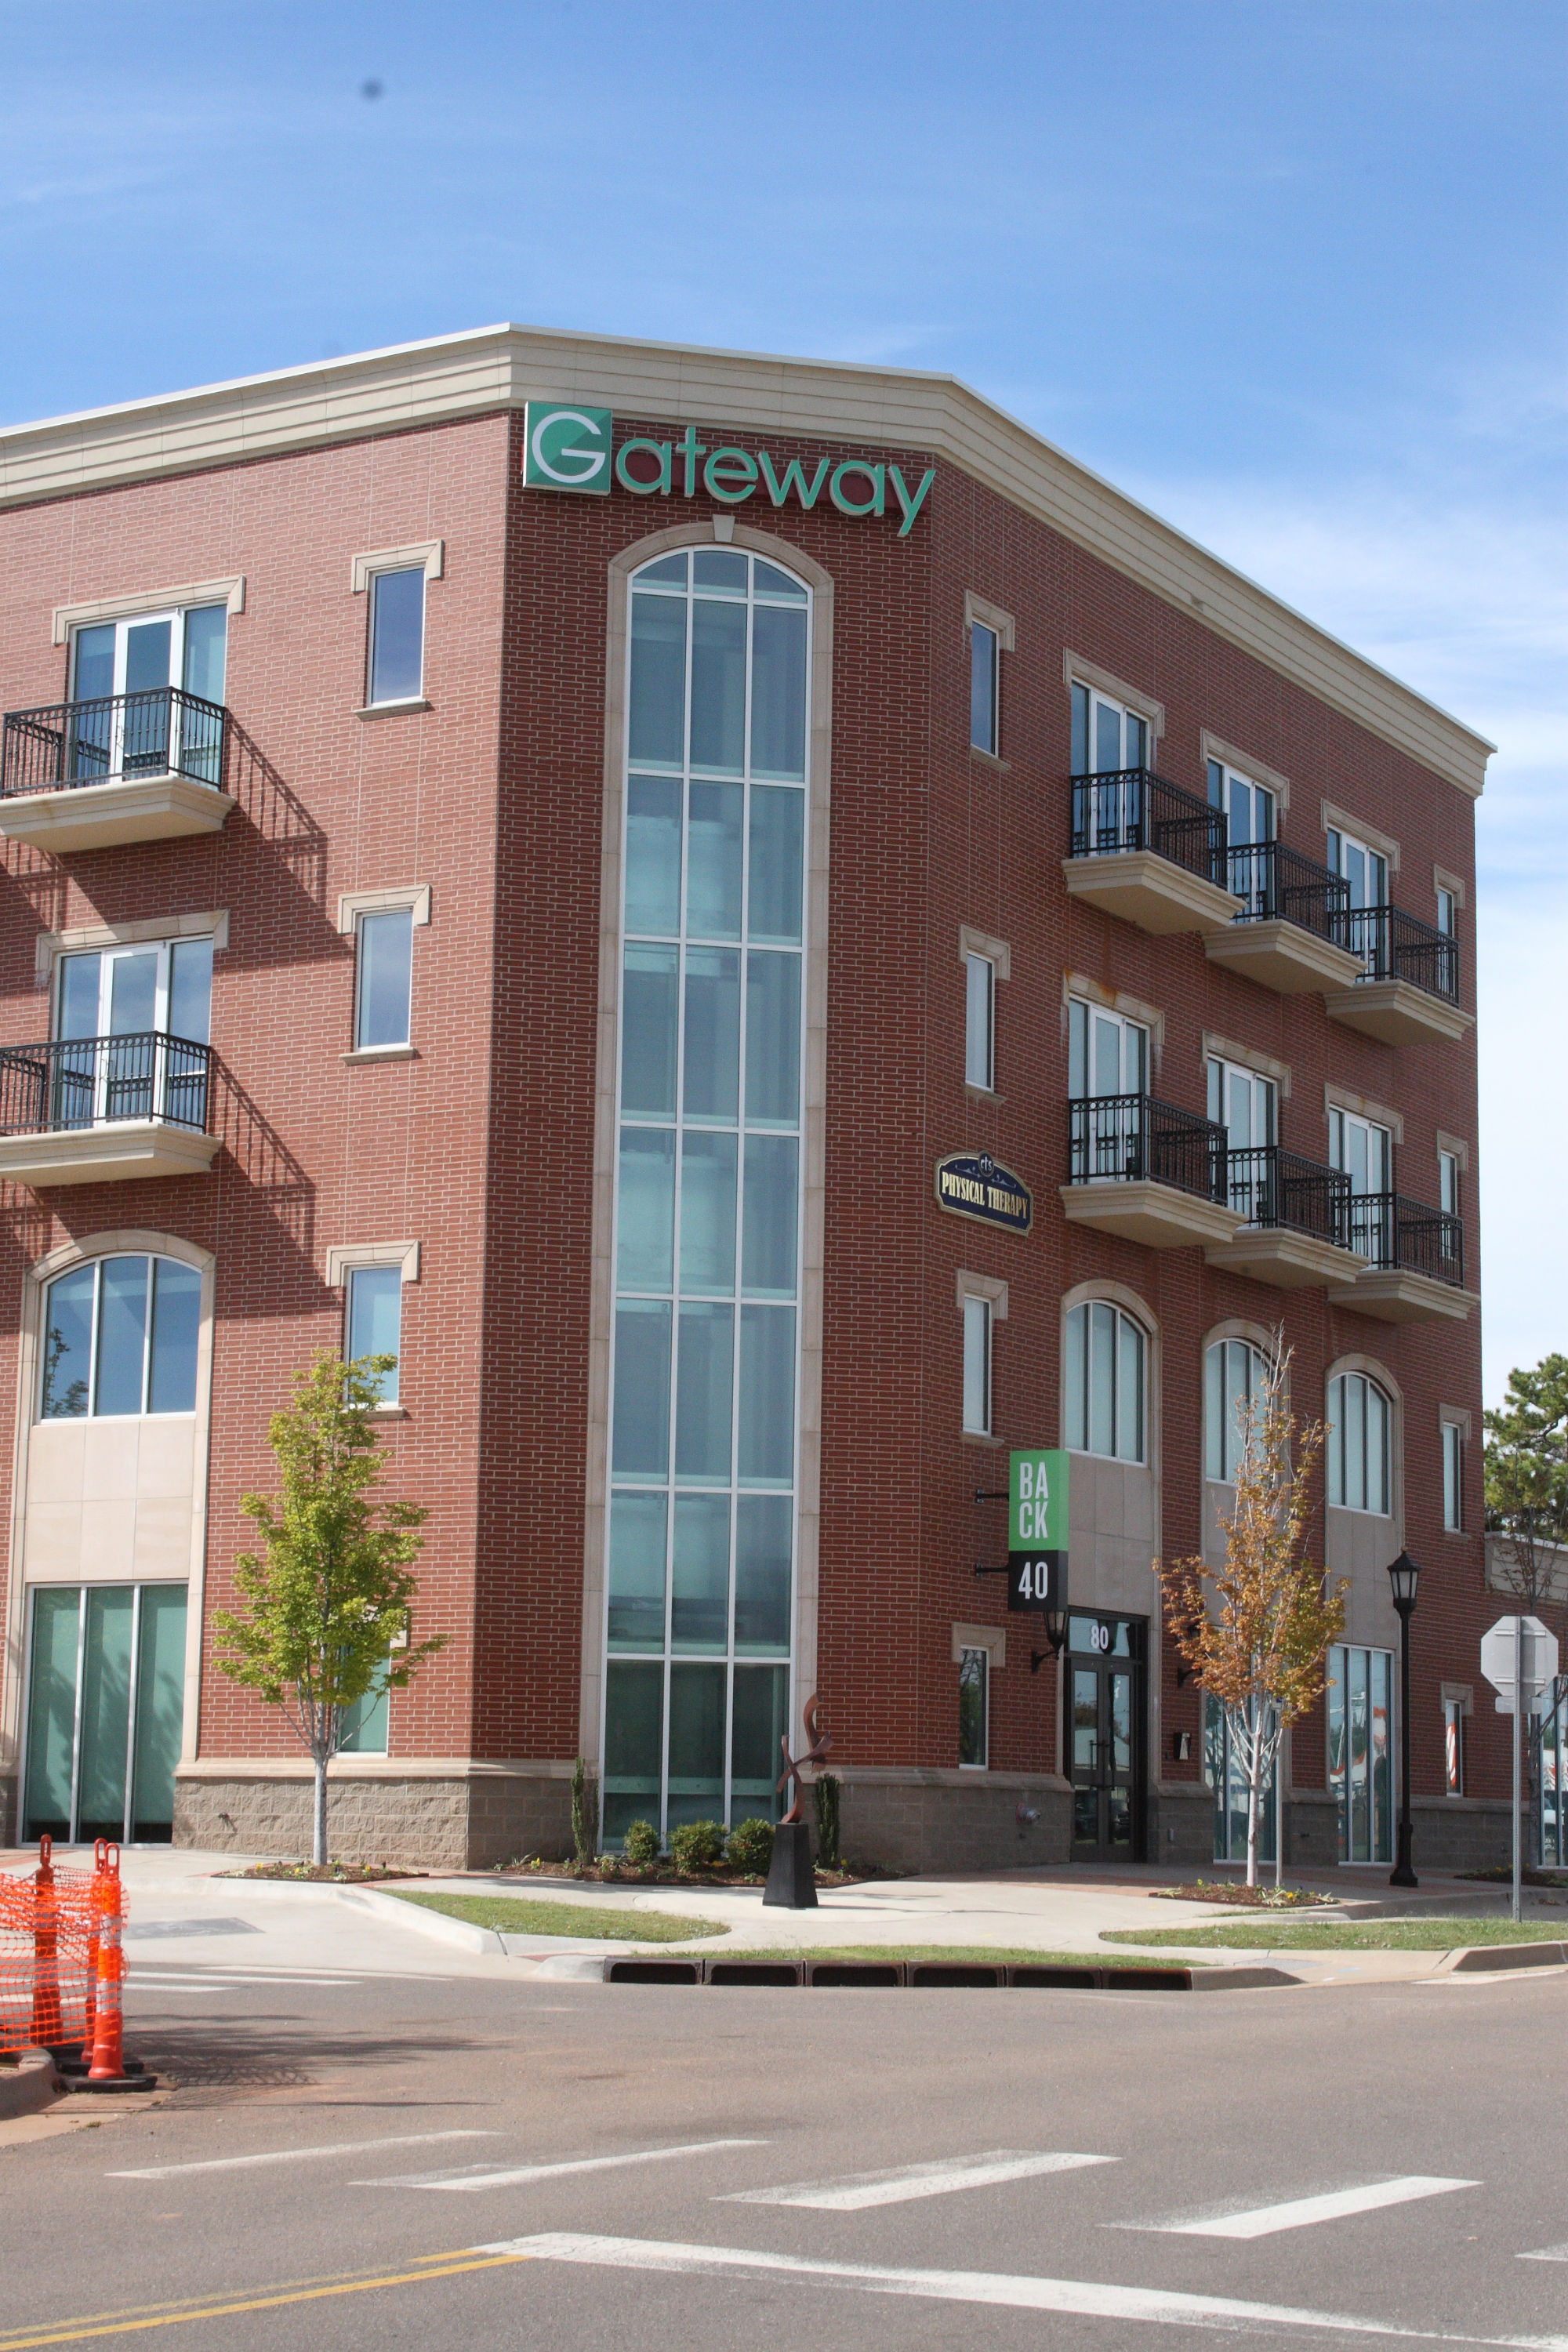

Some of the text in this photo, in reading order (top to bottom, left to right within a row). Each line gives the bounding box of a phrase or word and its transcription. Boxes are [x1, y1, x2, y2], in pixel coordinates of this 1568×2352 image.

[531, 411, 935, 536] Gateway
[942, 1172, 1028, 1219] PHYSICAL THERAPY
[1018, 1562, 1048, 1599] 40
[1091, 1625, 1109, 1650] 80
